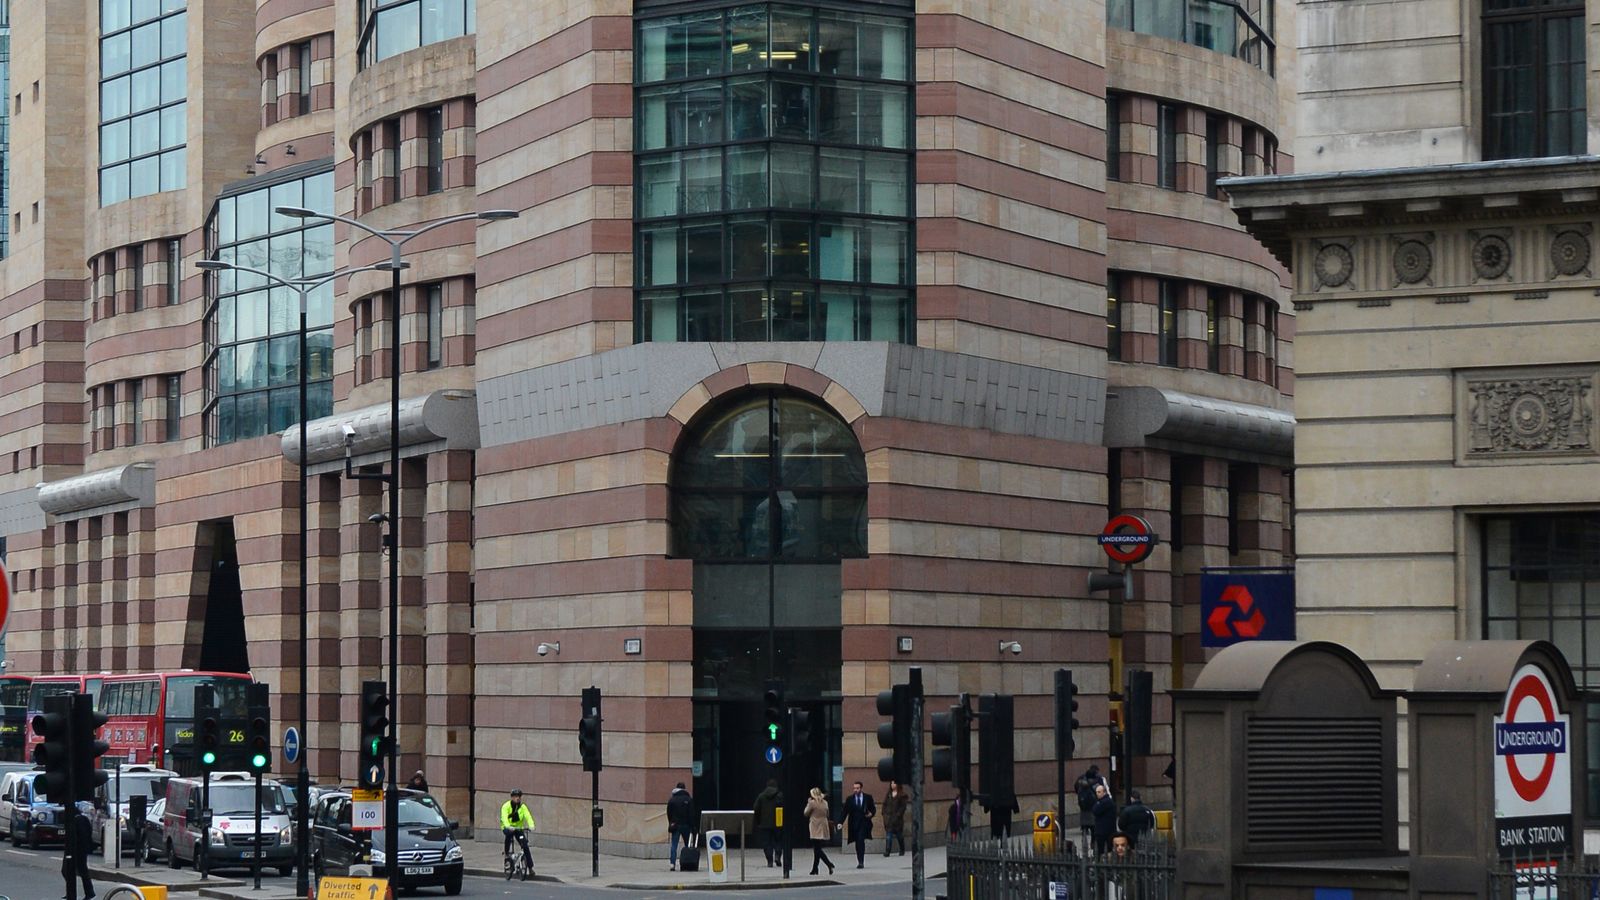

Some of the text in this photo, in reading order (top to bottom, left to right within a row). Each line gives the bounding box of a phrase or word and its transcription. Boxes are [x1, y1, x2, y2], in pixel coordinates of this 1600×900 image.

[229, 730, 245, 742] 26
[1498, 728, 1562, 749] UNDERGROUND
[361, 811, 376, 819] 100
[1500, 825, 1565, 846] BANK STATION
[323, 881, 362, 891] Diverted
[327, 891, 356, 900] traffic
